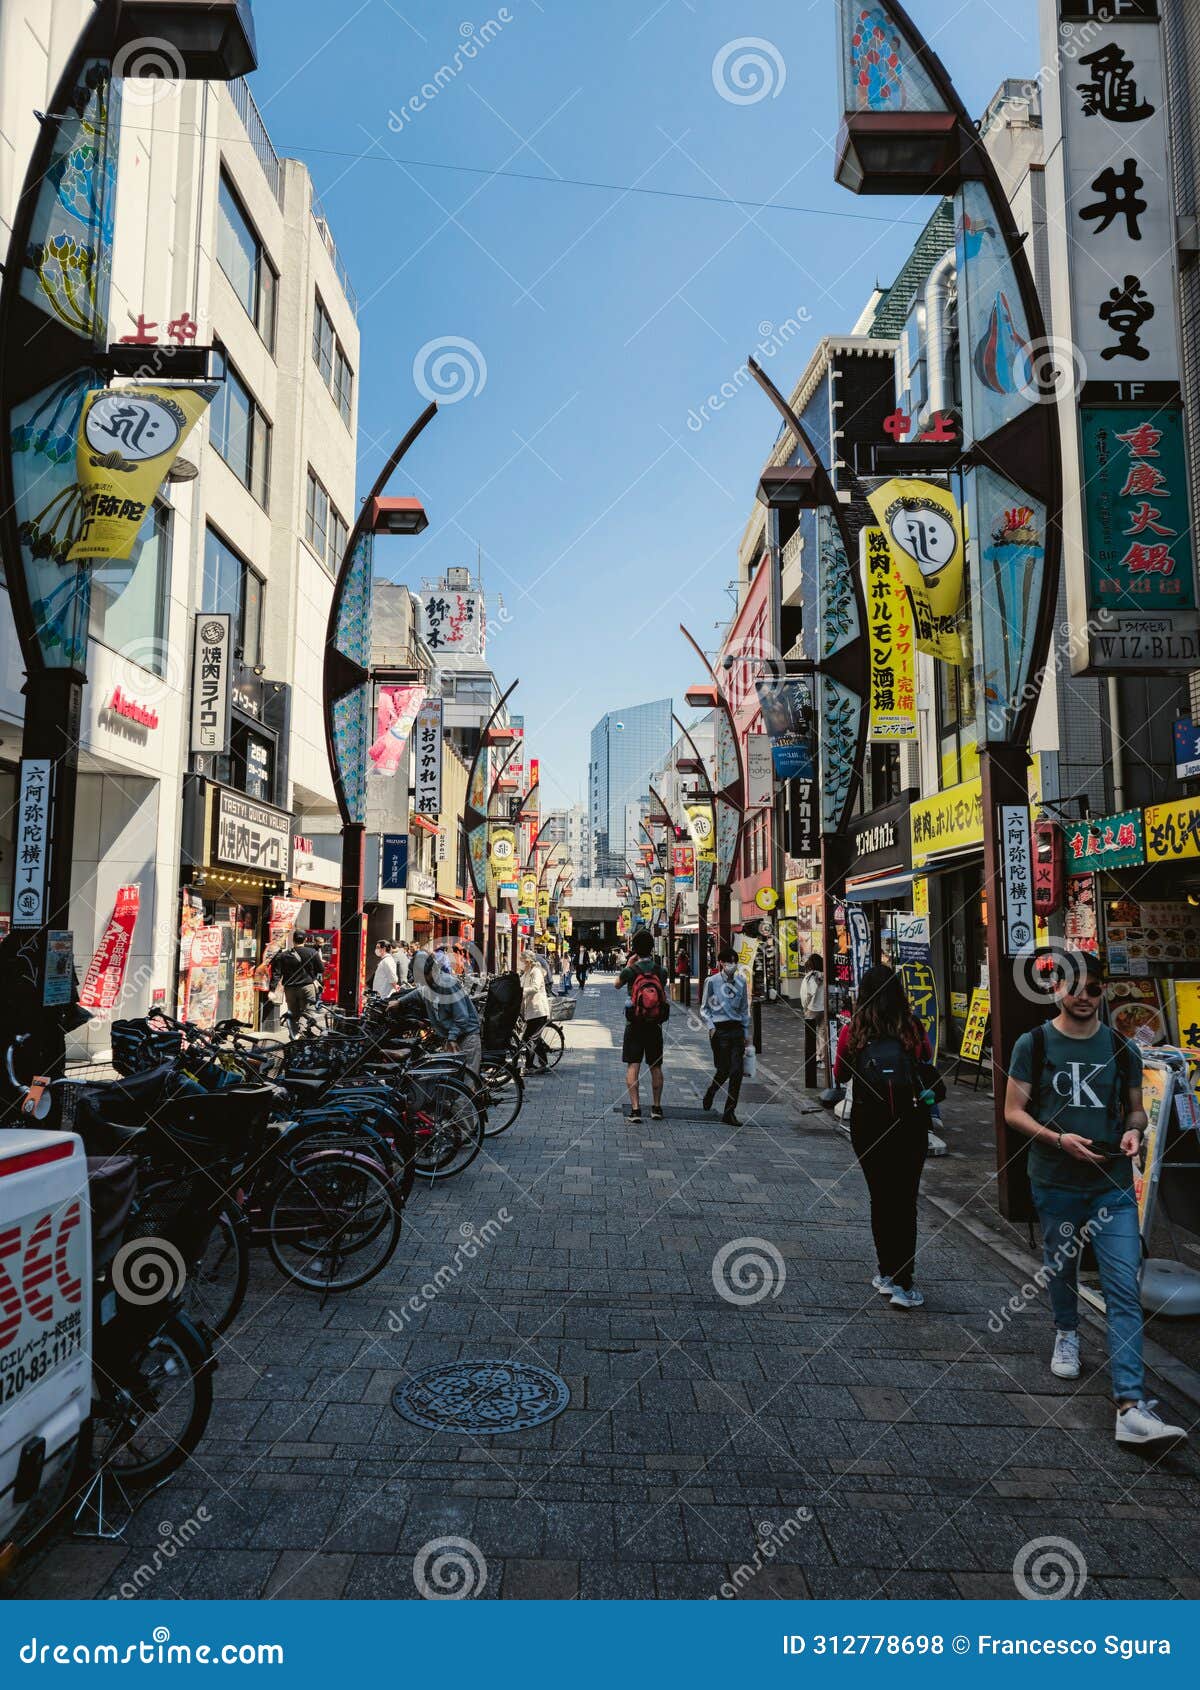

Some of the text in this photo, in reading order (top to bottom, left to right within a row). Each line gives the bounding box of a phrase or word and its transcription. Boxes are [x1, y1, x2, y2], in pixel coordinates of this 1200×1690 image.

[1114, 383, 1145, 400] 1F
[1116, 423, 1177, 575] 重慶火鍋
[868, 531, 895, 711] 焼肉&ホルモン酒場
[200, 646, 222, 727] 焼肉ライク
[873, 723, 915, 735] エンジョイ
[418, 728, 438, 812] おつかれ一杯
[20, 766, 46, 884] 六阿弥陀横丁
[223, 797, 247, 818] TASTY!
[1145, 808, 1160, 826] 3F
[219, 817, 280, 869] 焼肉ライク
[855, 820, 895, 857] サンマルクカフェ
[1008, 812, 1028, 917] 六阿弥陀横丁
[1069, 822, 1137, 859] 重慶火鍋
